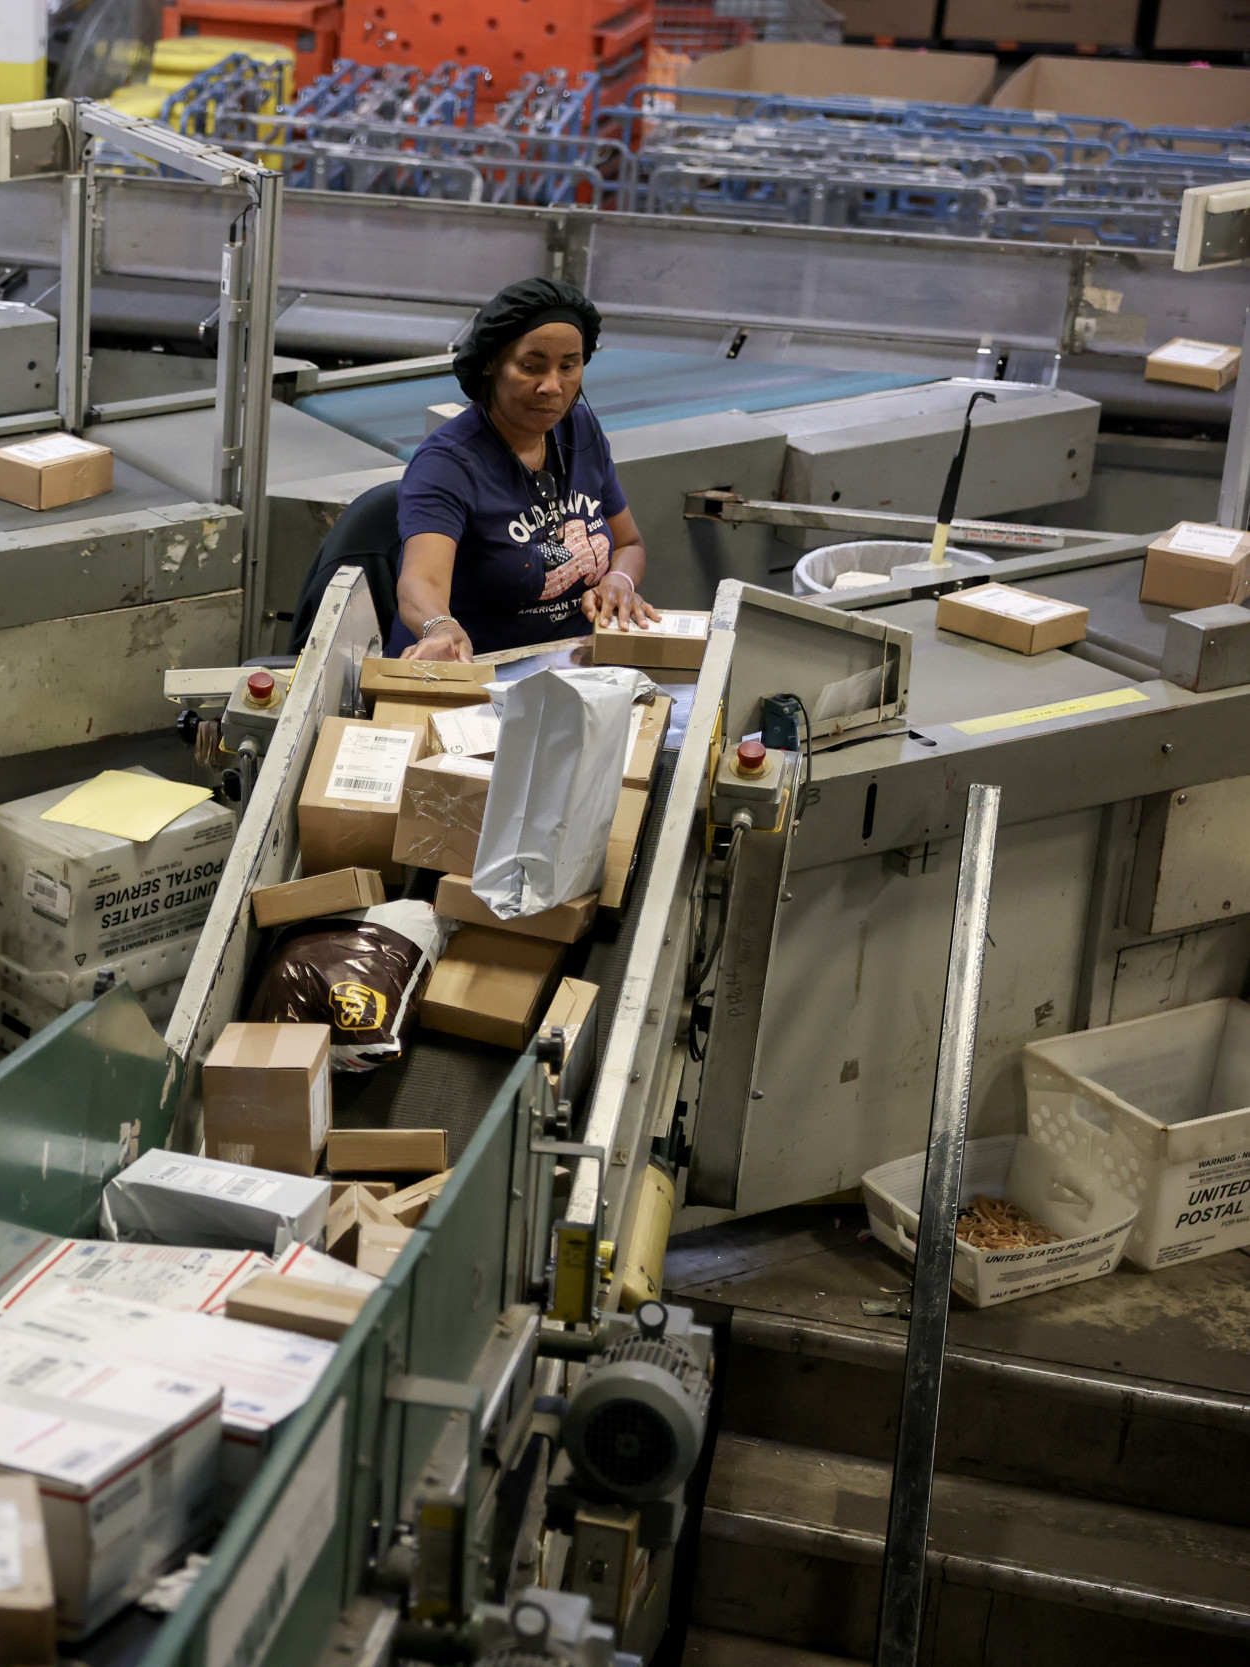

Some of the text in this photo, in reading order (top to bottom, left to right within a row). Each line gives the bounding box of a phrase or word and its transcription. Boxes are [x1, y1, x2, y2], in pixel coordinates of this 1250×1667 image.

[508, 505, 546, 543] OLD
[518, 601, 569, 615] AMERICAN
[140, 860, 183, 878] FOR MAIL ONLY
[94, 858, 224, 911] POSTAL SERVICE
[164, 880, 218, 909] UNITED
[101, 900, 160, 929] STATES
[150, 932, 164, 944] FOR
[166, 929, 180, 939] NOT
[104, 946, 118, 958] USE
[121, 938, 148, 952] PRIVATE
[1198, 1154, 1236, 1168] WARNING
[1188, 1179, 1250, 1206] UNITED
[1175, 1200, 1244, 1229] POSTAL
[986, 1253, 1026, 1264] UNITED
[1026, 1246, 1064, 1258] STATES
[1065, 1236, 1100, 1250] POSTAL
[1046, 1251, 1080, 1264] WARNING
[990, 1291, 1009, 1300] HALF
[1023, 1282, 1040, 1292] TRAY
